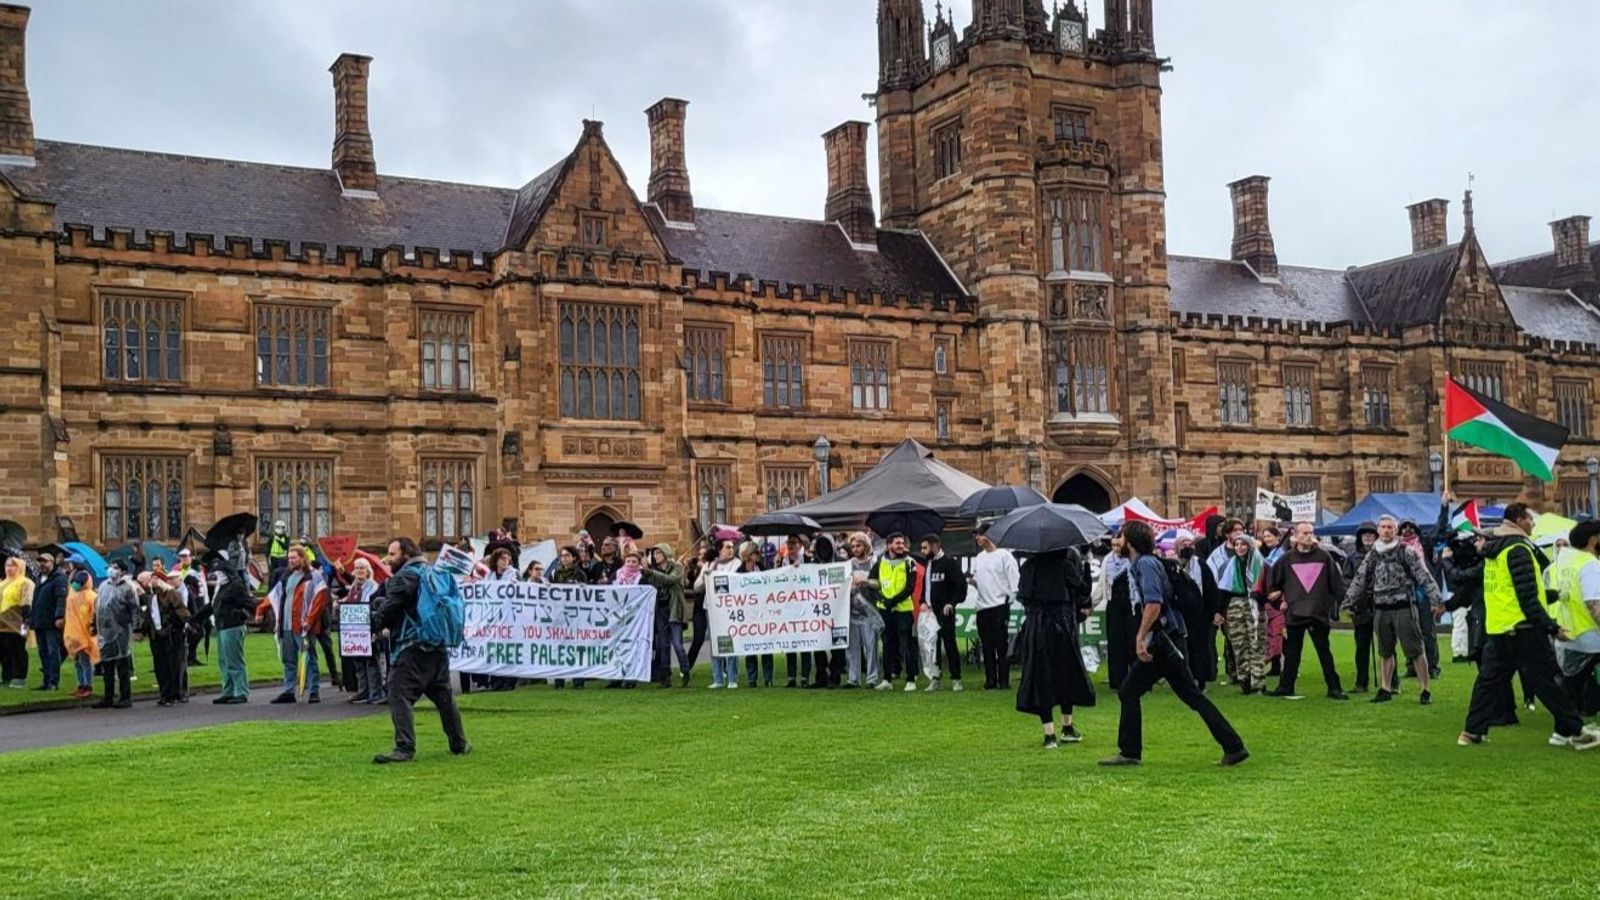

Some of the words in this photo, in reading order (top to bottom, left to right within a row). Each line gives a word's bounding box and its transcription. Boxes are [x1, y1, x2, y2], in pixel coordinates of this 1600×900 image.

[496, 584, 606, 602] COLLECTIVE
[715, 594, 758, 608] JEWS
[766, 587, 840, 604] AGAINST
[512, 601, 552, 623] צדק
[564, 606, 609, 627] צדק
[522, 626, 542, 639] YOU
[546, 627, 575, 640] SHALL
[728, 618, 835, 637] OCCUPATION
[478, 646, 484, 659] A
[486, 642, 523, 665] FREE
[530, 643, 608, 666] PALESTINE
